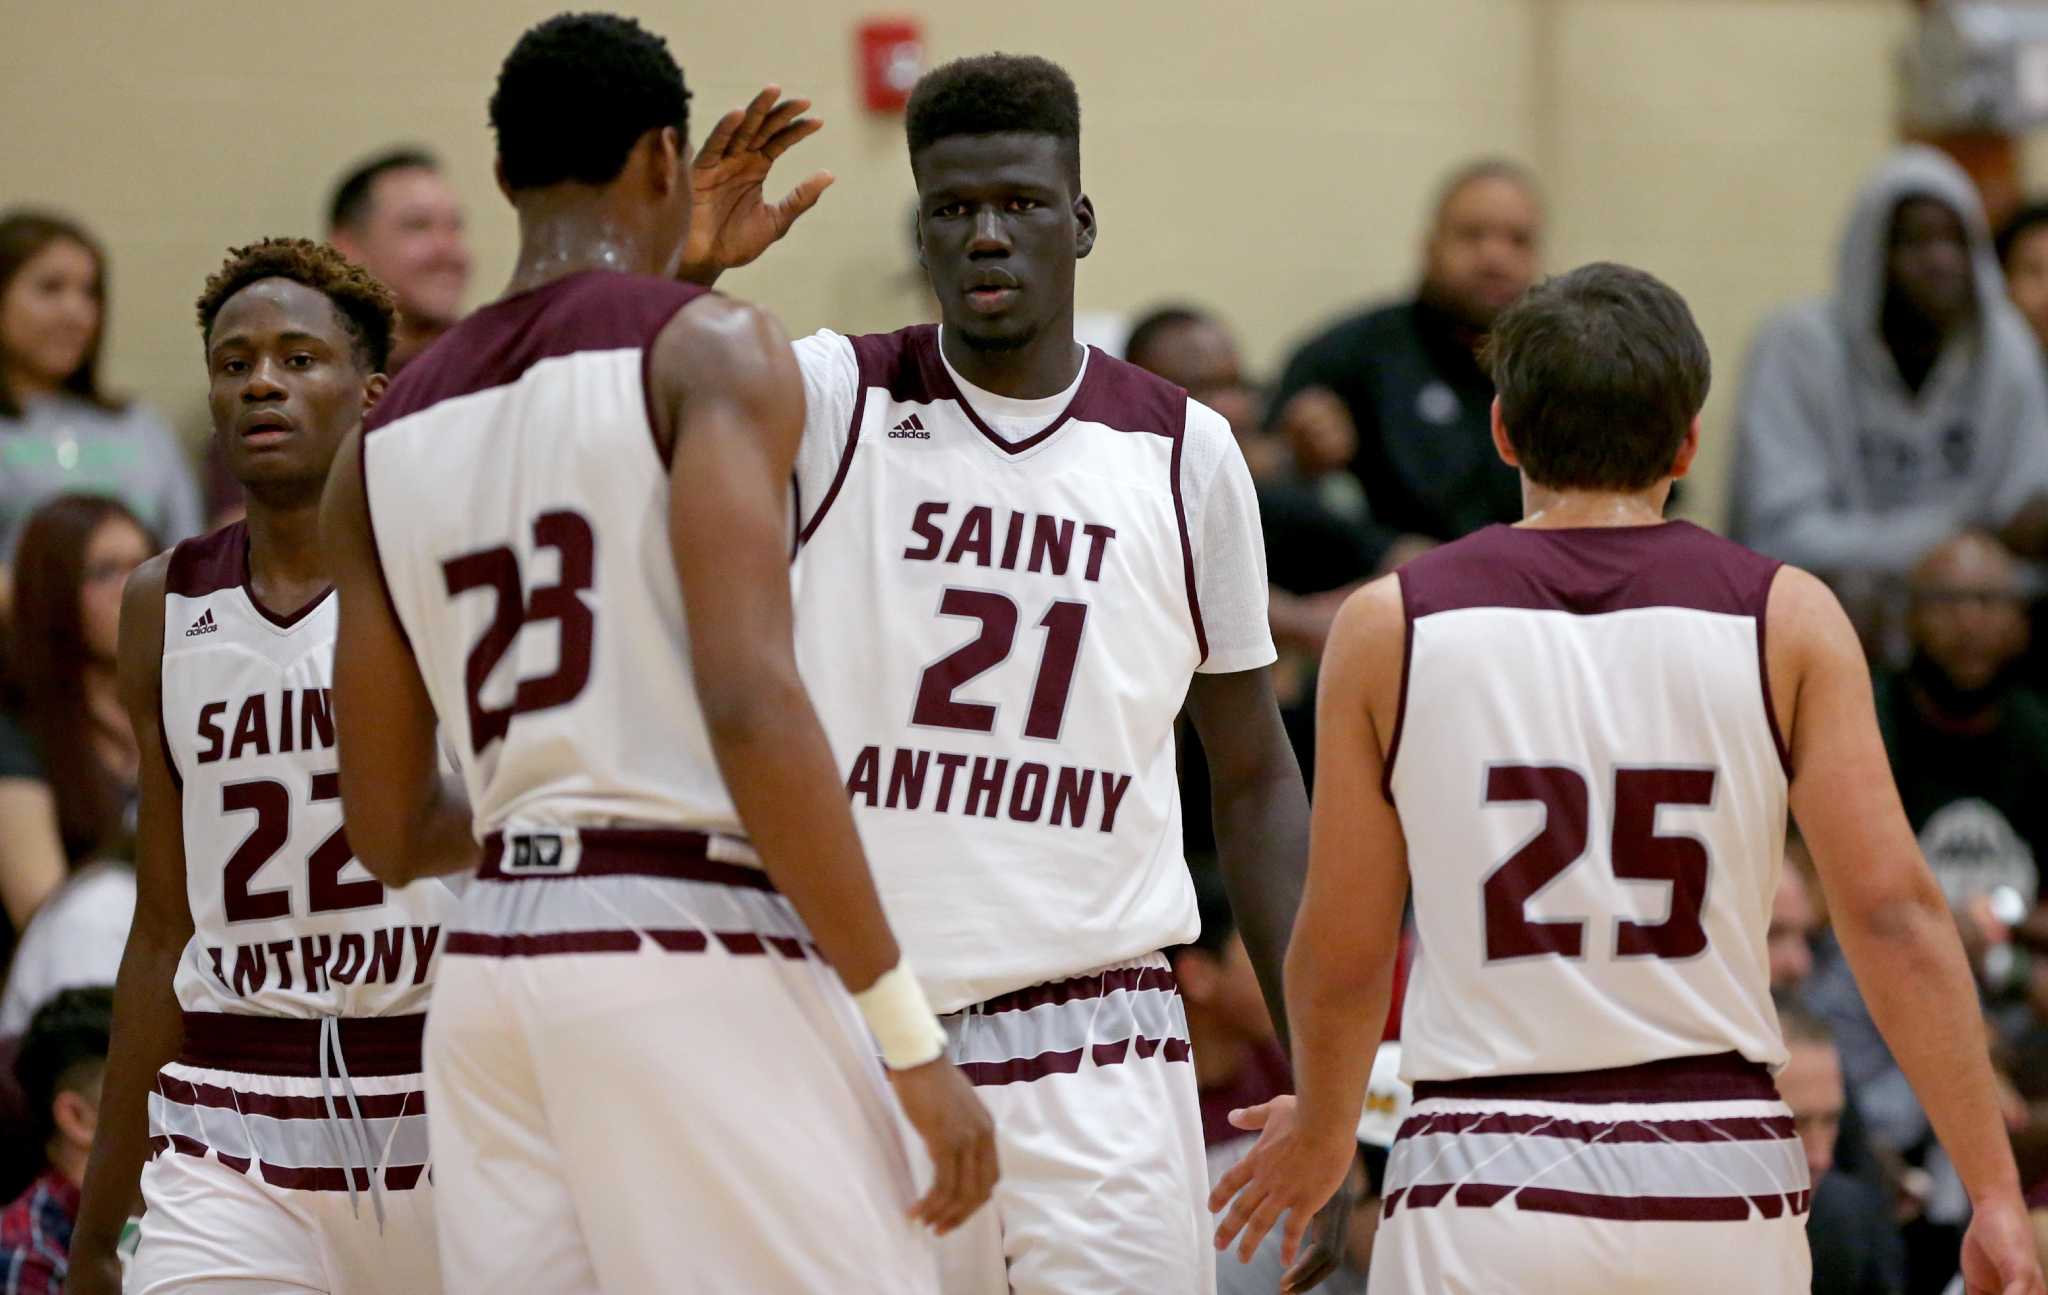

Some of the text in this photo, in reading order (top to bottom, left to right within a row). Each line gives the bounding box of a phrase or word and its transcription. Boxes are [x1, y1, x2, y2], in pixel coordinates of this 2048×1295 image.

[888, 428, 931, 440] adidas
[903, 501, 1117, 583] SAINT
[185, 623, 218, 637] adidas
[441, 509, 595, 758] 23
[907, 584, 1089, 743] 21
[196, 687, 336, 765] SAIN
[846, 745, 1132, 834] ANTHONY
[220, 768, 387, 928] 22
[1477, 759, 1719, 967] 25
